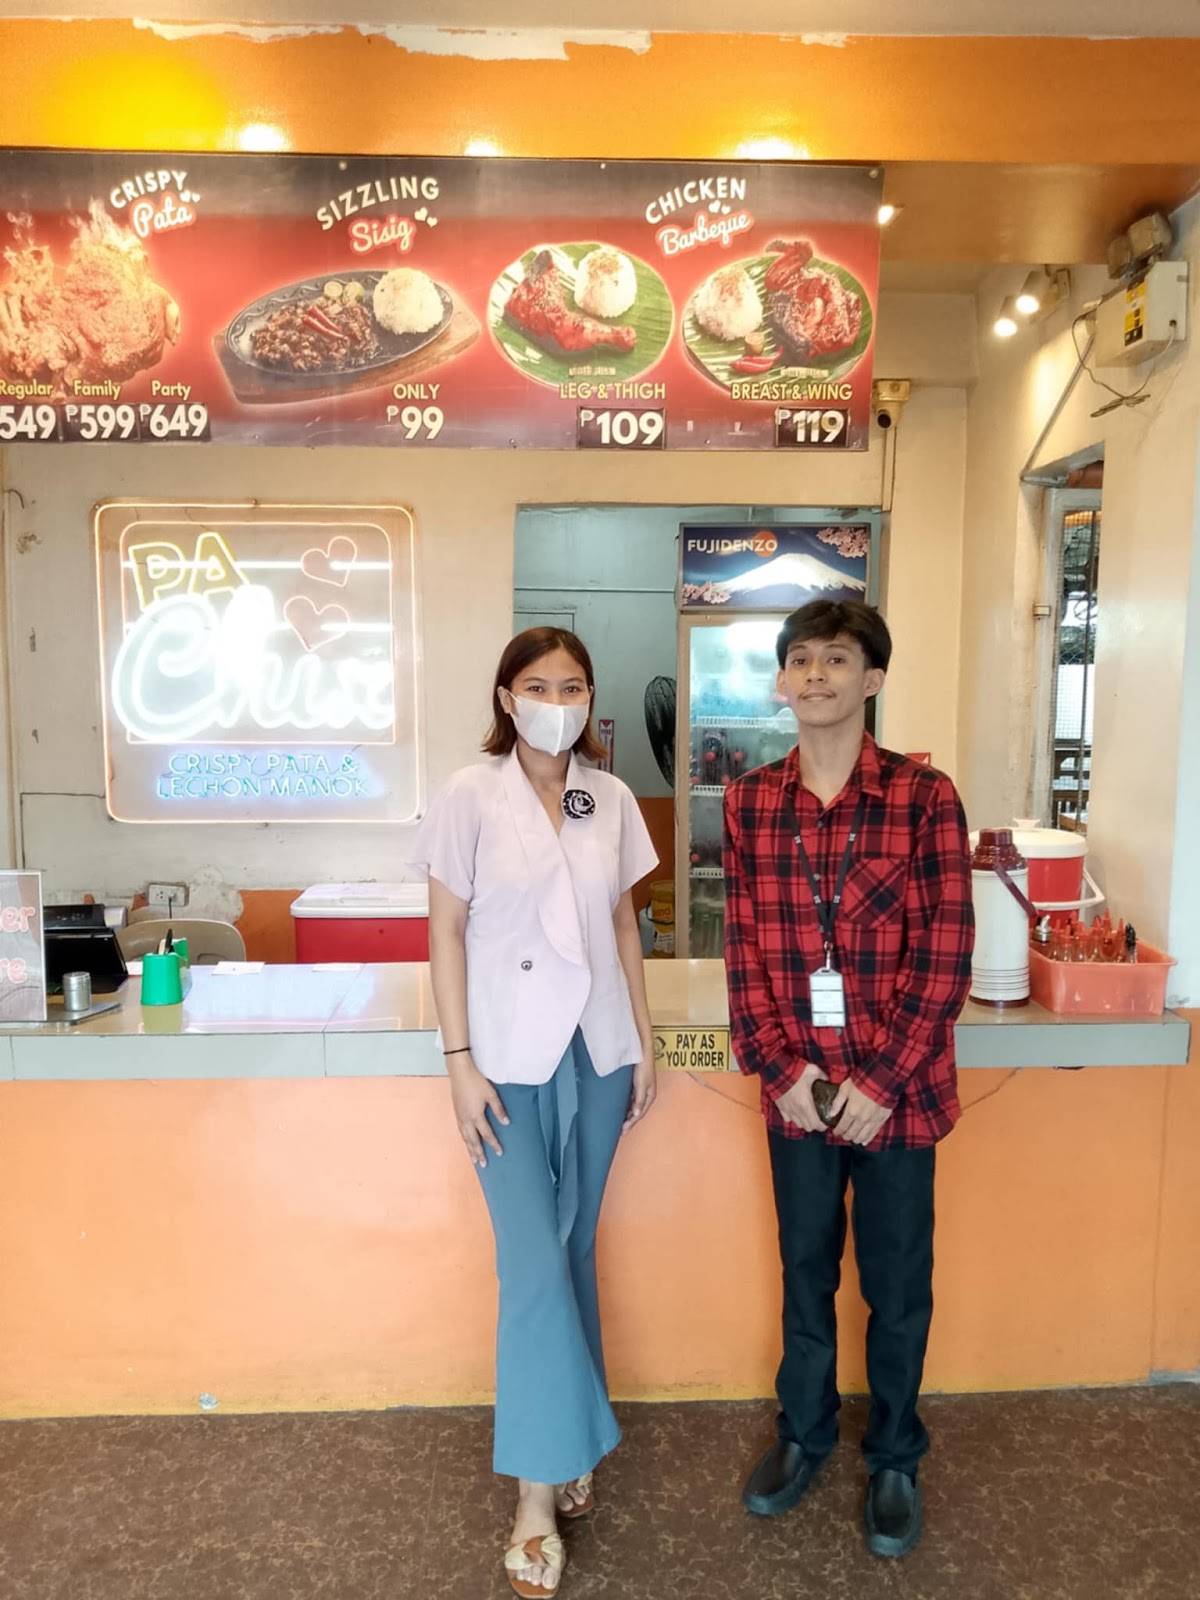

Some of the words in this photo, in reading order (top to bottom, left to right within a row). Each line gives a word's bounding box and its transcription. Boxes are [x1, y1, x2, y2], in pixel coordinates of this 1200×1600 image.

[110, 169, 188, 209] CRISPY
[316, 176, 440, 231] SIZZLING
[645, 176, 747, 225] CHICKEN
[133, 195, 193, 238] Pata
[351, 217, 414, 252] Sisig
[658, 213, 752, 256] Barbeque
[0, 379, 53, 399] Regular
[74, 379, 121, 400] Family
[152, 380, 191, 400] Party
[393, 383, 440, 400] ONLY
[560, 382, 592, 400] LEG
[597, 382, 608, 400] &
[614, 382, 666, 400] THIGH
[731, 383, 787, 400] BREAST
[792, 383, 802, 400] &
[808, 383, 853, 401] WING
[687, 538, 778, 554] FUJIDENZO
[168, 753, 257, 775] CRISPY
[267, 753, 329, 775] PATA
[341, 753, 359, 775] &
[156, 776, 261, 798] LECHON
[270, 776, 368, 798] MANOK
[676, 1033, 697, 1049] PAY
[700, 1033, 715, 1049] AS
[666, 1051, 687, 1067] YOU
[690, 1051, 724, 1067] ORDER
